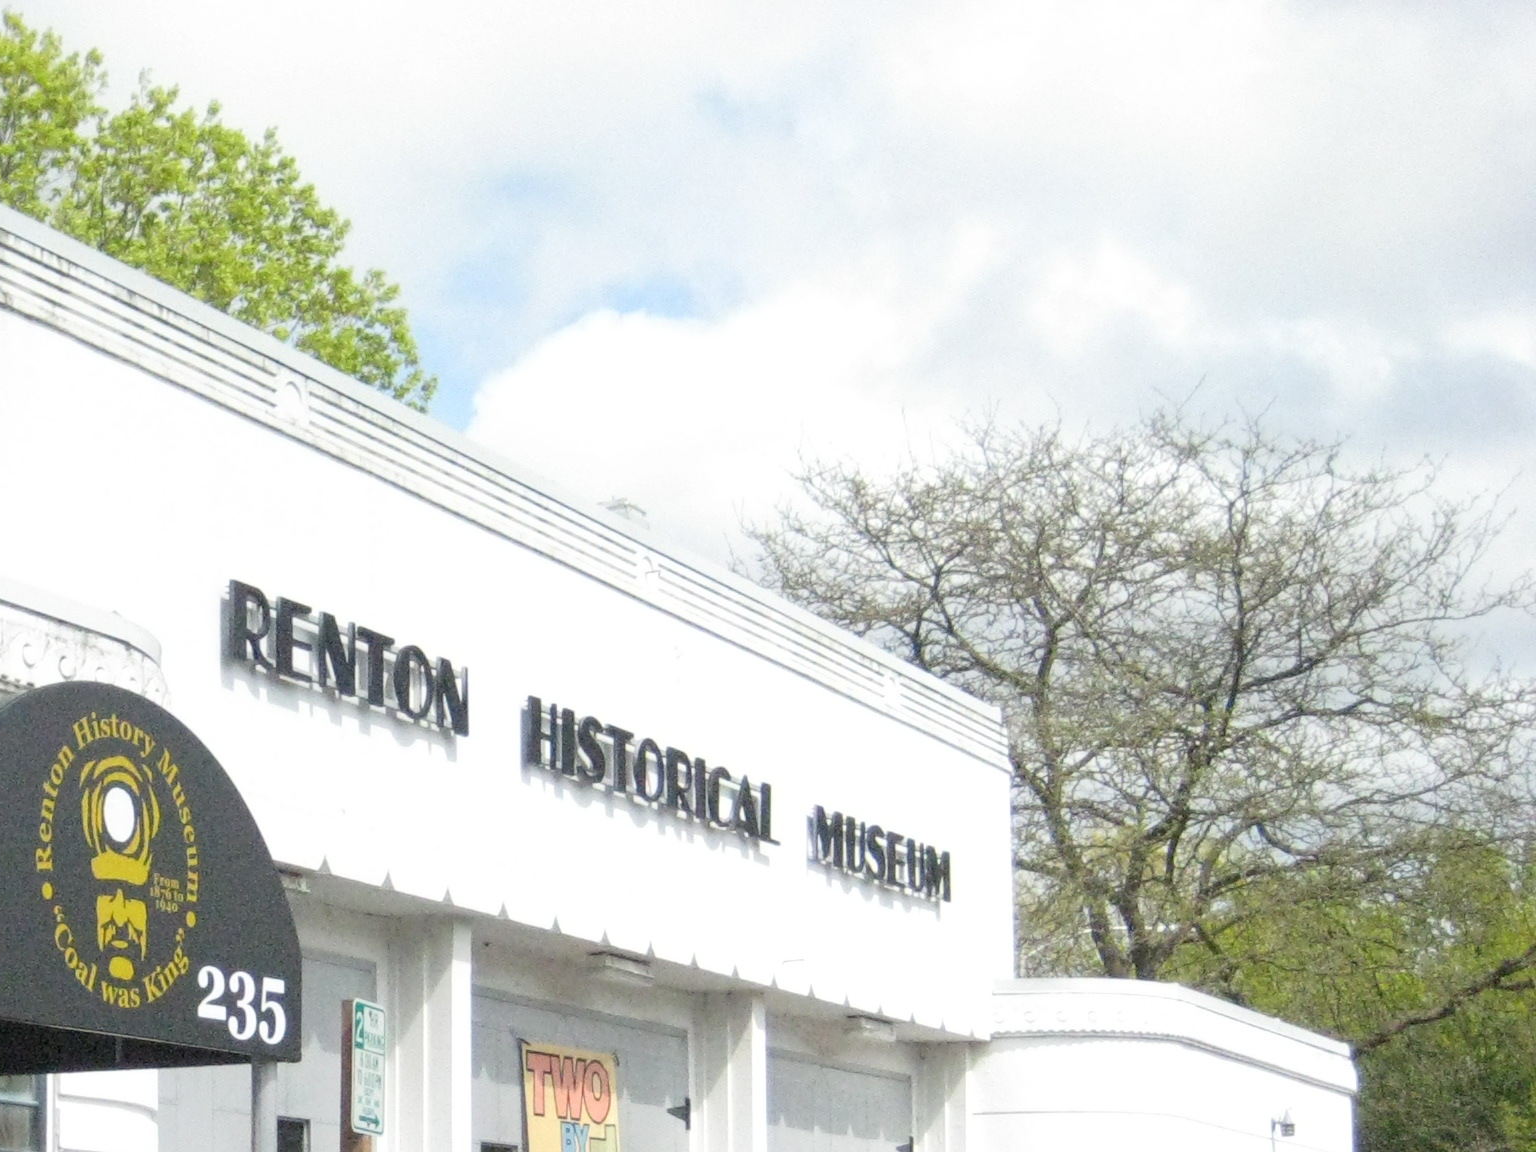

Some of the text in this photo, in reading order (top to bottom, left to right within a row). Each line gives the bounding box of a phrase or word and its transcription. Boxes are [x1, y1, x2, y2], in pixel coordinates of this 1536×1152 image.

[229, 578, 952, 903] RENTON HISTORICAL MUSEUM
[35, 711, 200, 904] Renton History Museum
[101, 980, 142, 1009] was
[196, 965, 287, 1046] 235
[525, 1050, 611, 1124] TWO
